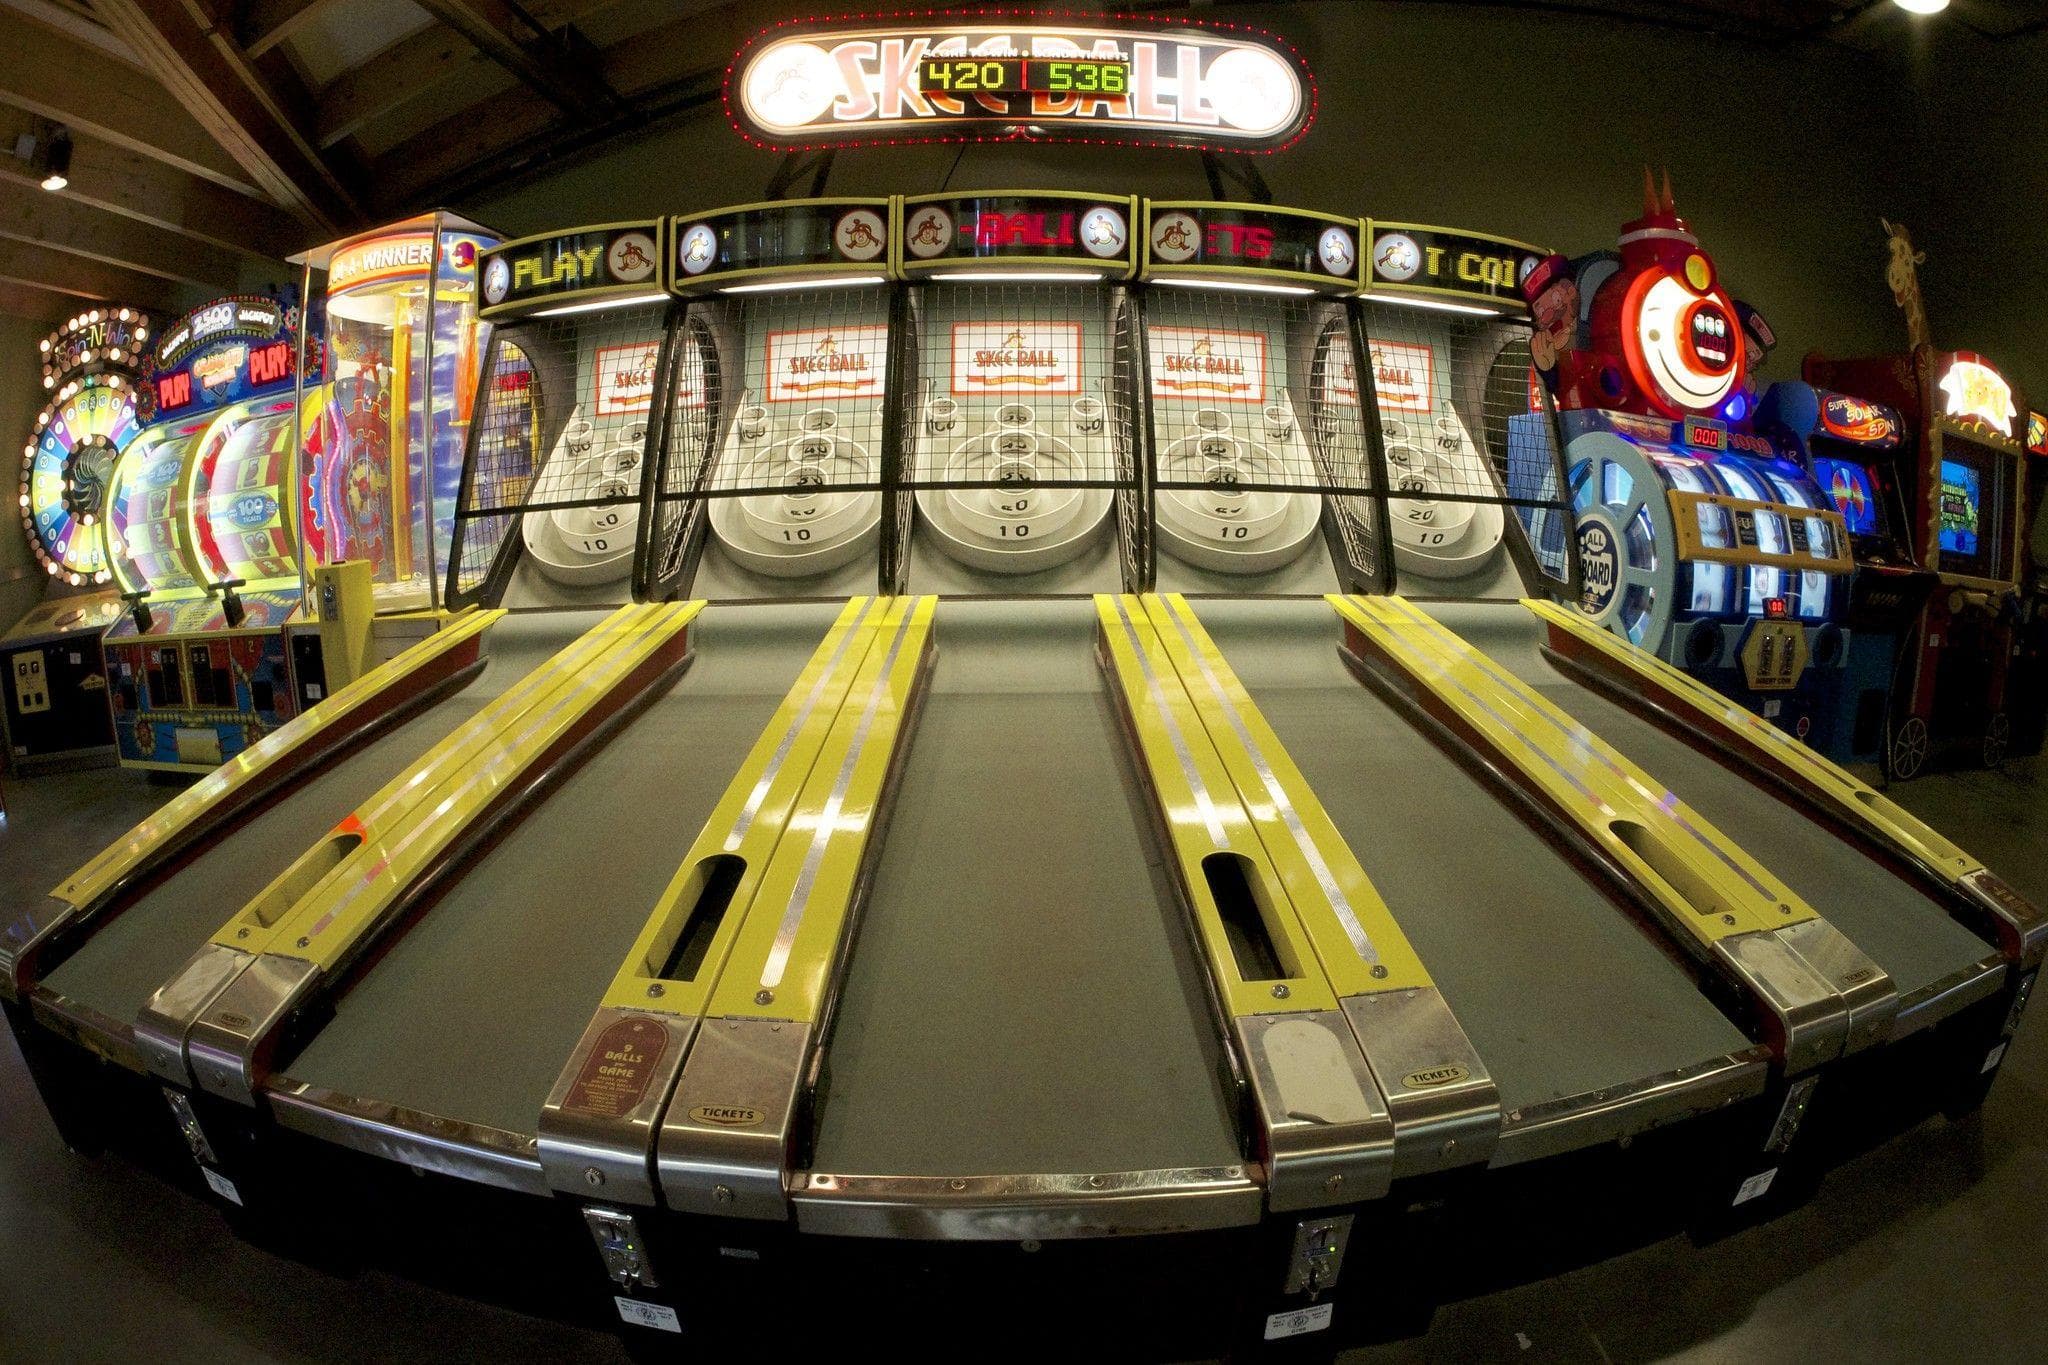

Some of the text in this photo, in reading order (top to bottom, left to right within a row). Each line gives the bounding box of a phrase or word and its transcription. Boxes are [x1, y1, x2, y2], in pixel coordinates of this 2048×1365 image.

[929, 62, 1004, 89] 420
[1050, 63, 1123, 91] 536
[515, 245, 603, 289] PLAY
[194, 306, 233, 336] 2500
[238, 309, 276, 326] JACKPOT
[250, 344, 288, 383] PLAY
[788, 353, 868, 374] SKEE BALL
[974, 350, 1057, 367] SKEE BALL
[1166, 355, 1244, 375] SKEE BALL
[1378, 367, 1413, 386] BALL
[159, 373, 191, 409] PLAY
[1846, 405, 1883, 423] SOLAR
[1868, 419, 1896, 437] SPIN
[1694, 429, 1718, 446] 000
[237, 498, 264, 516] 100
[1408, 509, 1434, 521] 20
[783, 529, 811, 541] 10
[1000, 525, 1029, 537] 10
[1221, 527, 1249, 538] 10
[1420, 533, 1445, 544] 10
[583, 538, 608, 551] 10
[1586, 533, 1604, 547] ALL
[604, 1051, 643, 1063] BALLS
[598, 1066, 636, 1078] GAME
[1411, 1067, 1459, 1083] TICKETS
[703, 1107, 755, 1119] TICKETS
